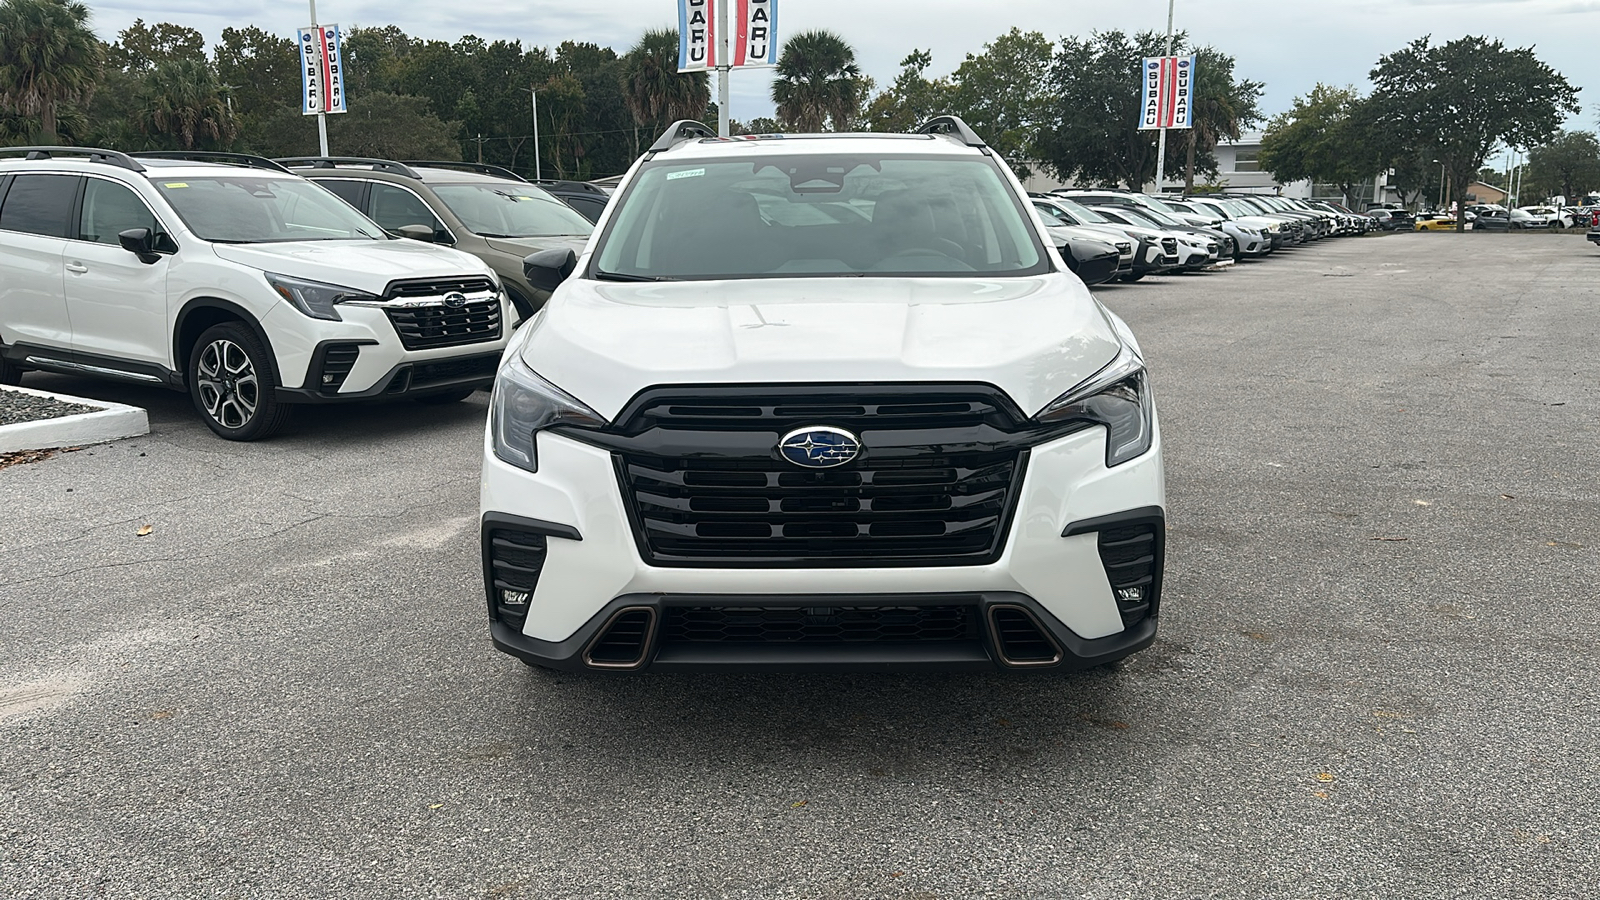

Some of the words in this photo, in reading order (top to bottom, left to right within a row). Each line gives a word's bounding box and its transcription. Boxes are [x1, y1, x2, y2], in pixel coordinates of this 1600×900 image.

[751, 0, 768, 58] ARU
[327, 42, 340, 106] SUBARU
[1146, 72, 1158, 124] SUBARU
[1176, 70, 1188, 123] SUBARU
